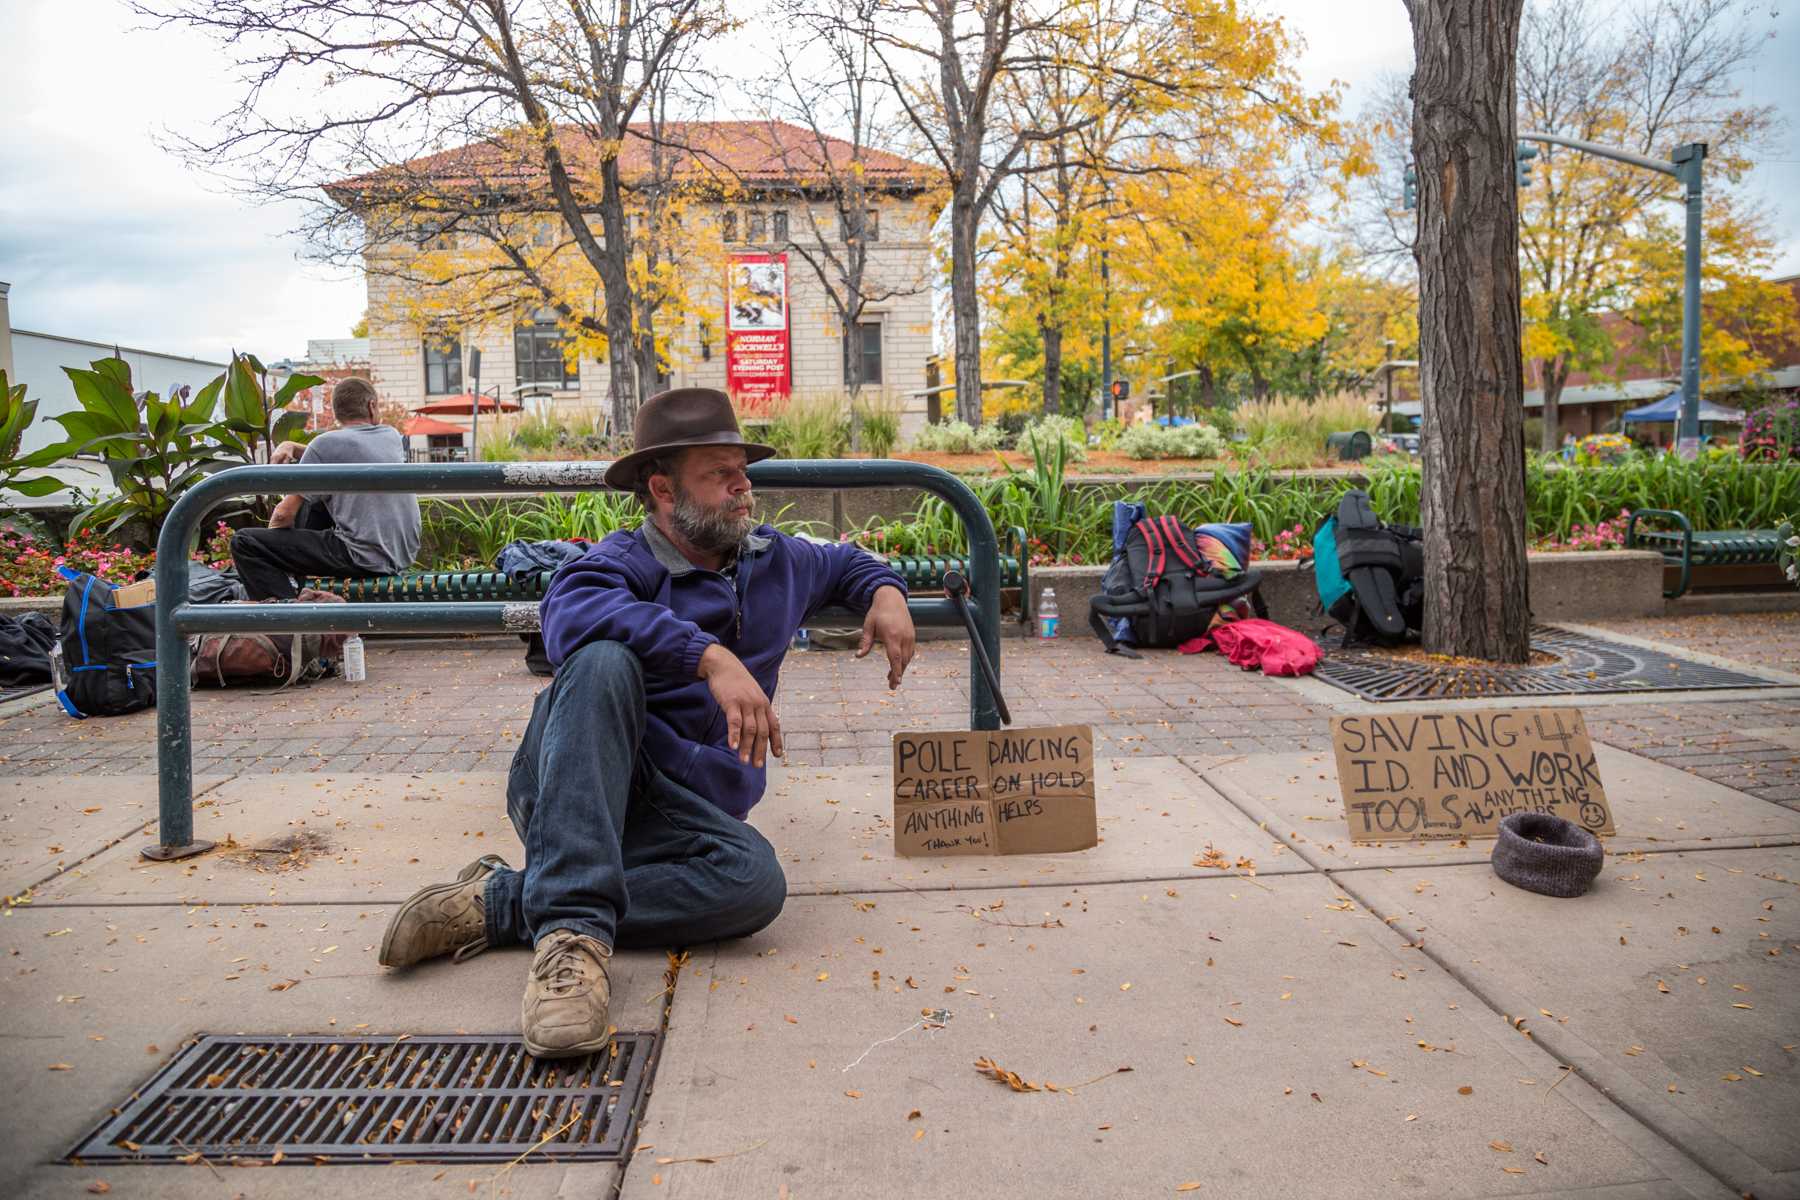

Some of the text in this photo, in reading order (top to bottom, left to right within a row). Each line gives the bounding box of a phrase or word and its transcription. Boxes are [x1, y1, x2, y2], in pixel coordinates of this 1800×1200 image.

[1341, 713, 1519, 753] SAVING
[899, 737, 1079, 773] POLE DANCING
[1352, 751, 1603, 793] I.D. AND WORK
[896, 771, 1086, 801] CAREER ON HOLD
[1485, 787, 1590, 807] ANYTHING
[904, 800, 1043, 835] ANYTHING HELPS
[1352, 794, 1462, 833] TOOLS
